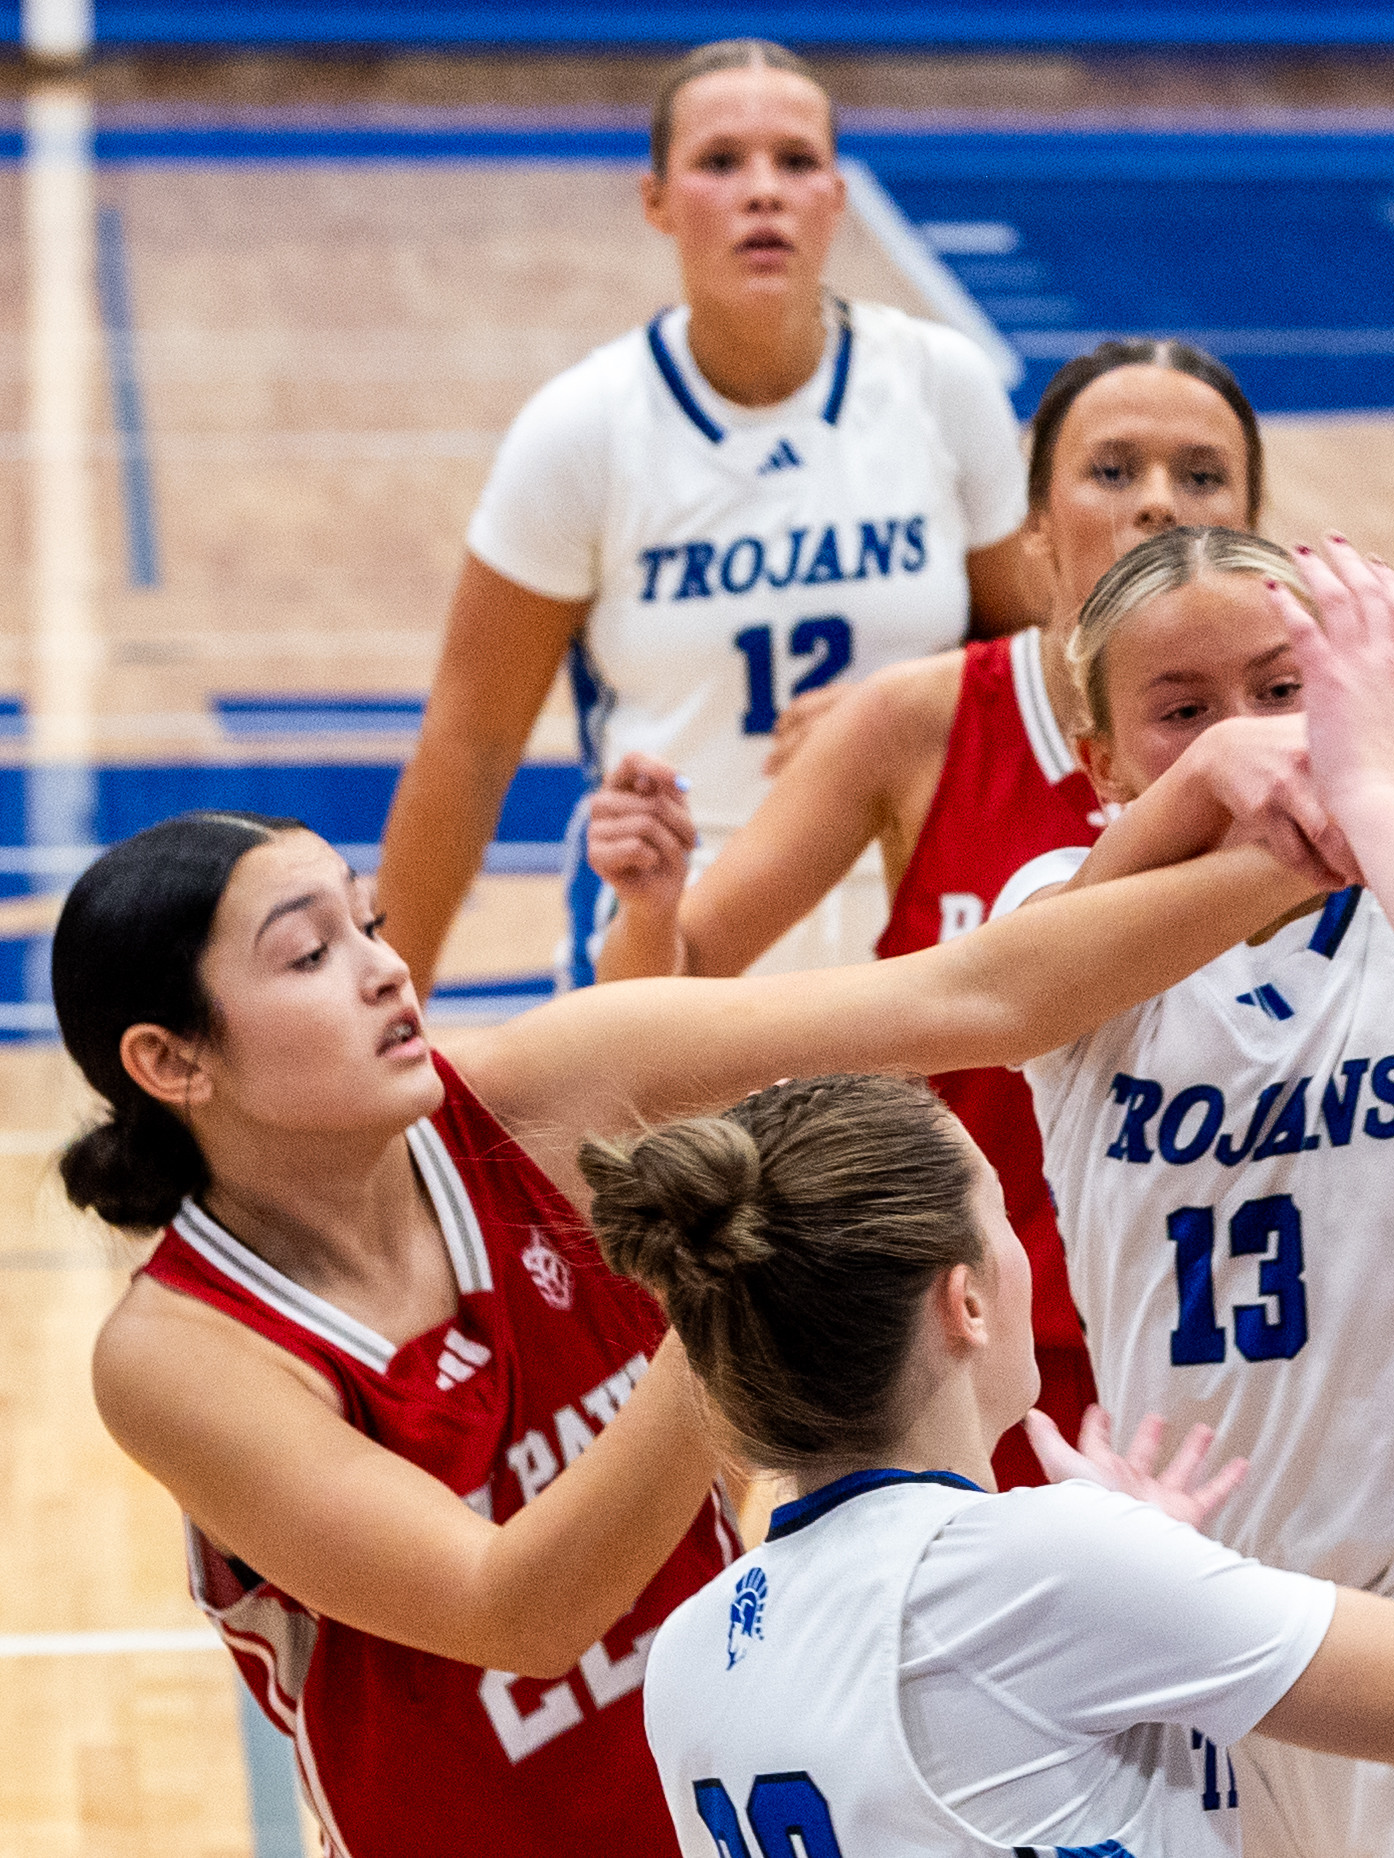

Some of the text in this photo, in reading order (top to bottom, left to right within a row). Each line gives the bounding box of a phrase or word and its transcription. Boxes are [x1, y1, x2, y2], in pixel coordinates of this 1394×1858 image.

[638, 511, 926, 603] TROJANS
[733, 613, 855, 736] 12
[1166, 1193, 1309, 1367] 13
